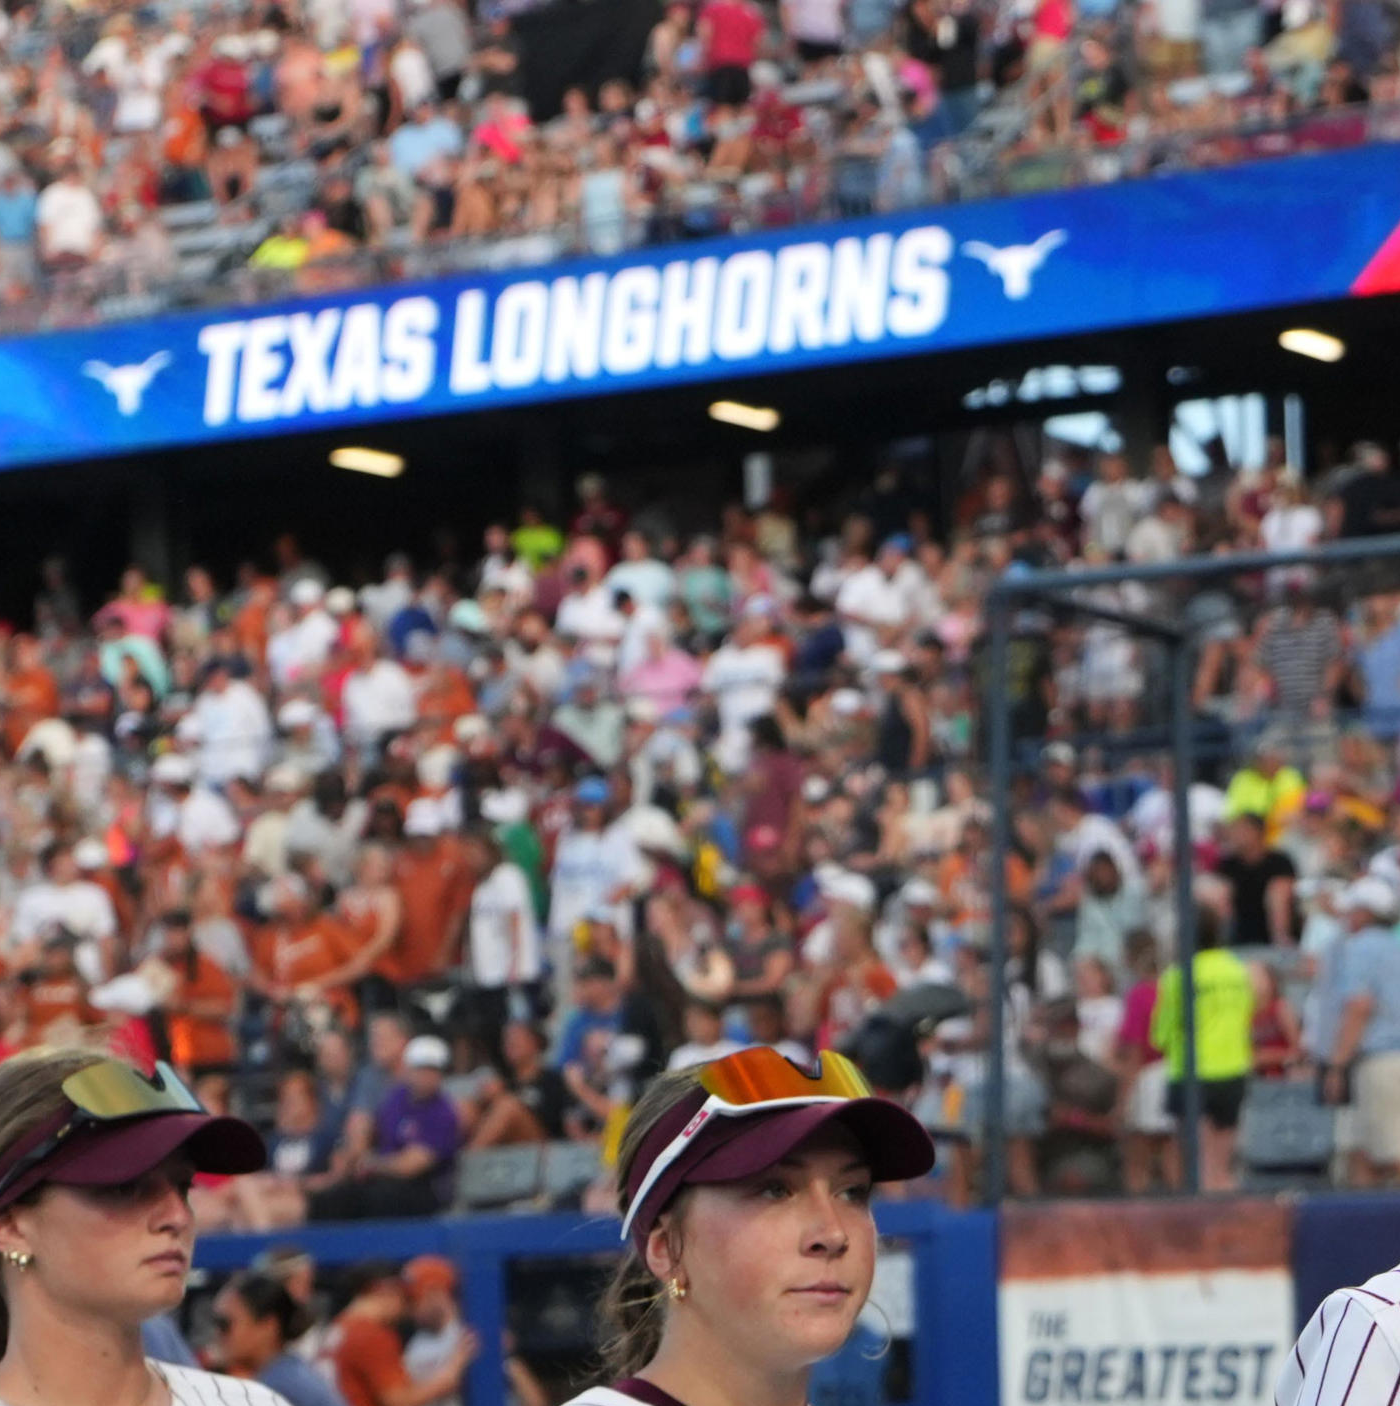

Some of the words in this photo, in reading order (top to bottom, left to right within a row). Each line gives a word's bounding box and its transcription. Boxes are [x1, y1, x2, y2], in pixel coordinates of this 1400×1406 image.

[199, 296, 439, 427] TEXAS
[449, 226, 953, 394] LONGHORNS
[1031, 1312, 1068, 1339] THE
[1023, 1345, 1276, 1403] GREATEST
